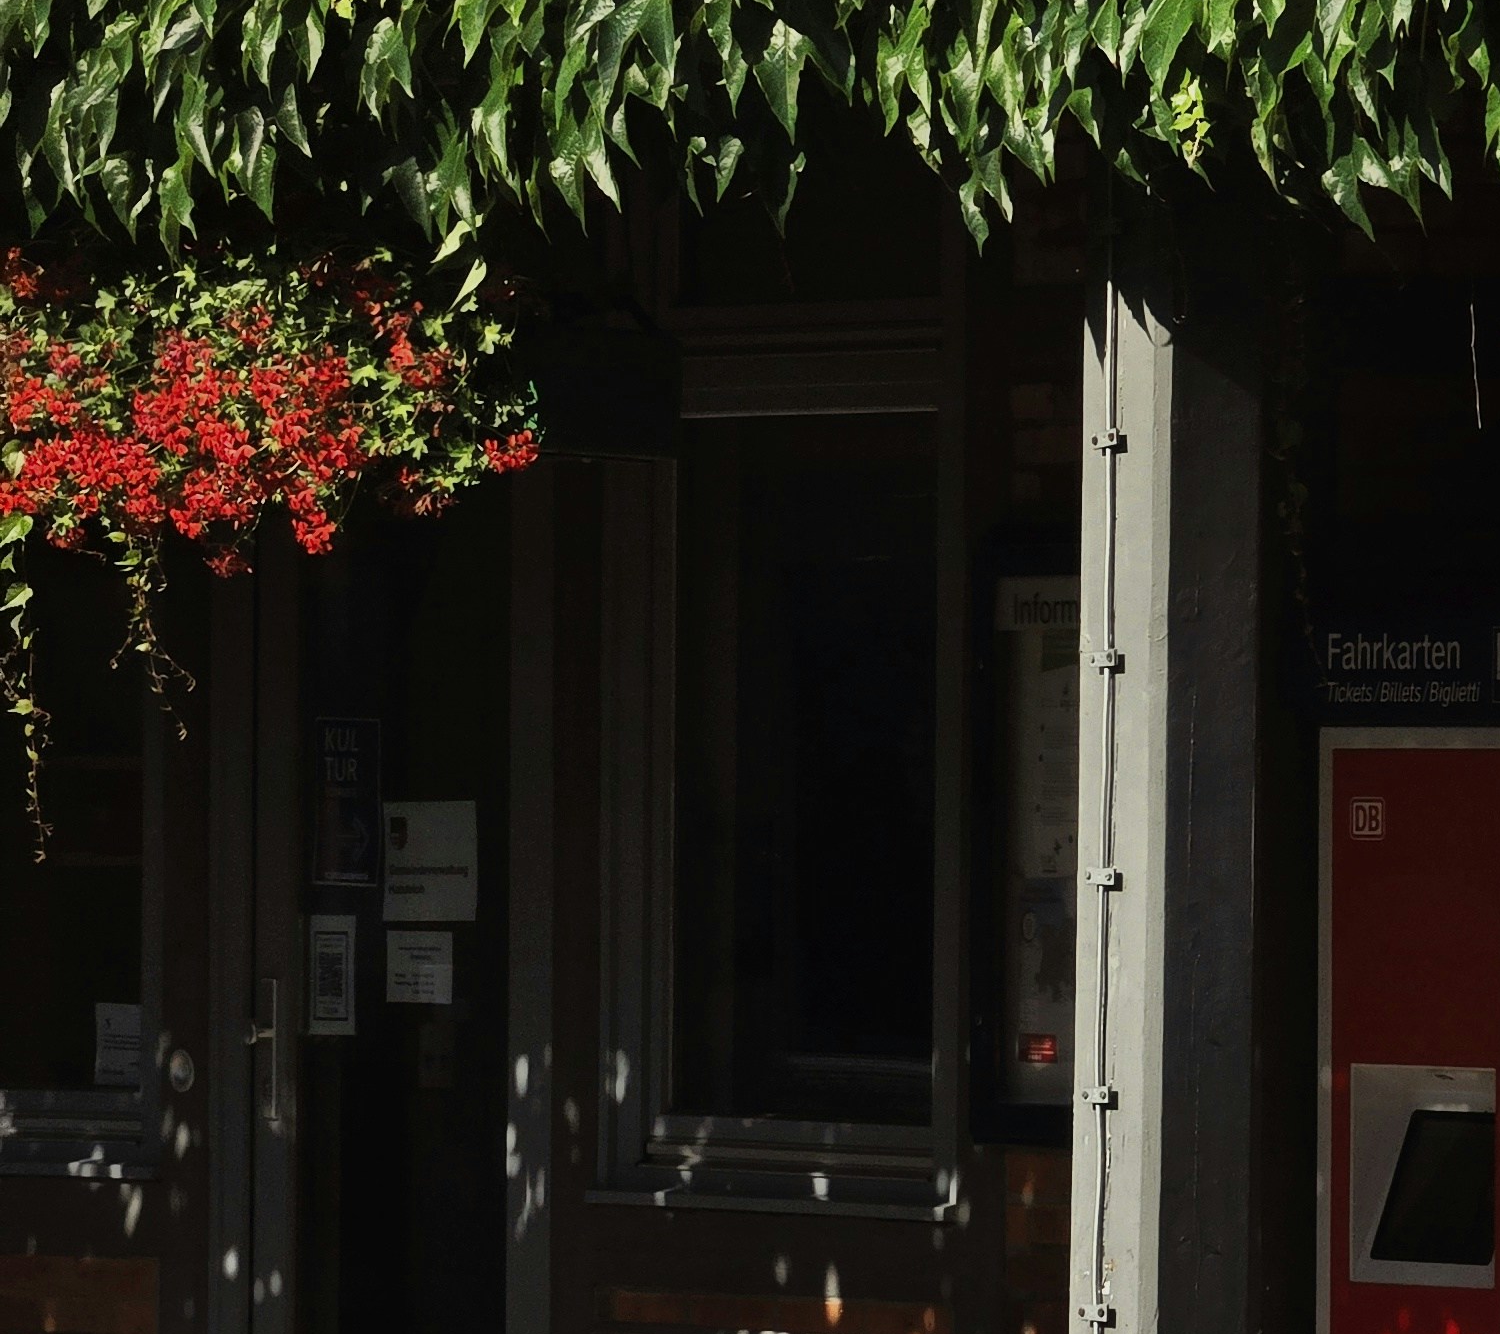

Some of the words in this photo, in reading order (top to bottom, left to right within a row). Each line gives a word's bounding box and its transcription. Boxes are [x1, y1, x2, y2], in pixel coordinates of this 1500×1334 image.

[1327, 632, 1461, 670] Fahrkarten
[324, 727, 359, 752] KUL
[324, 756, 358, 781] TUR
[1355, 805, 1380, 832] DB
